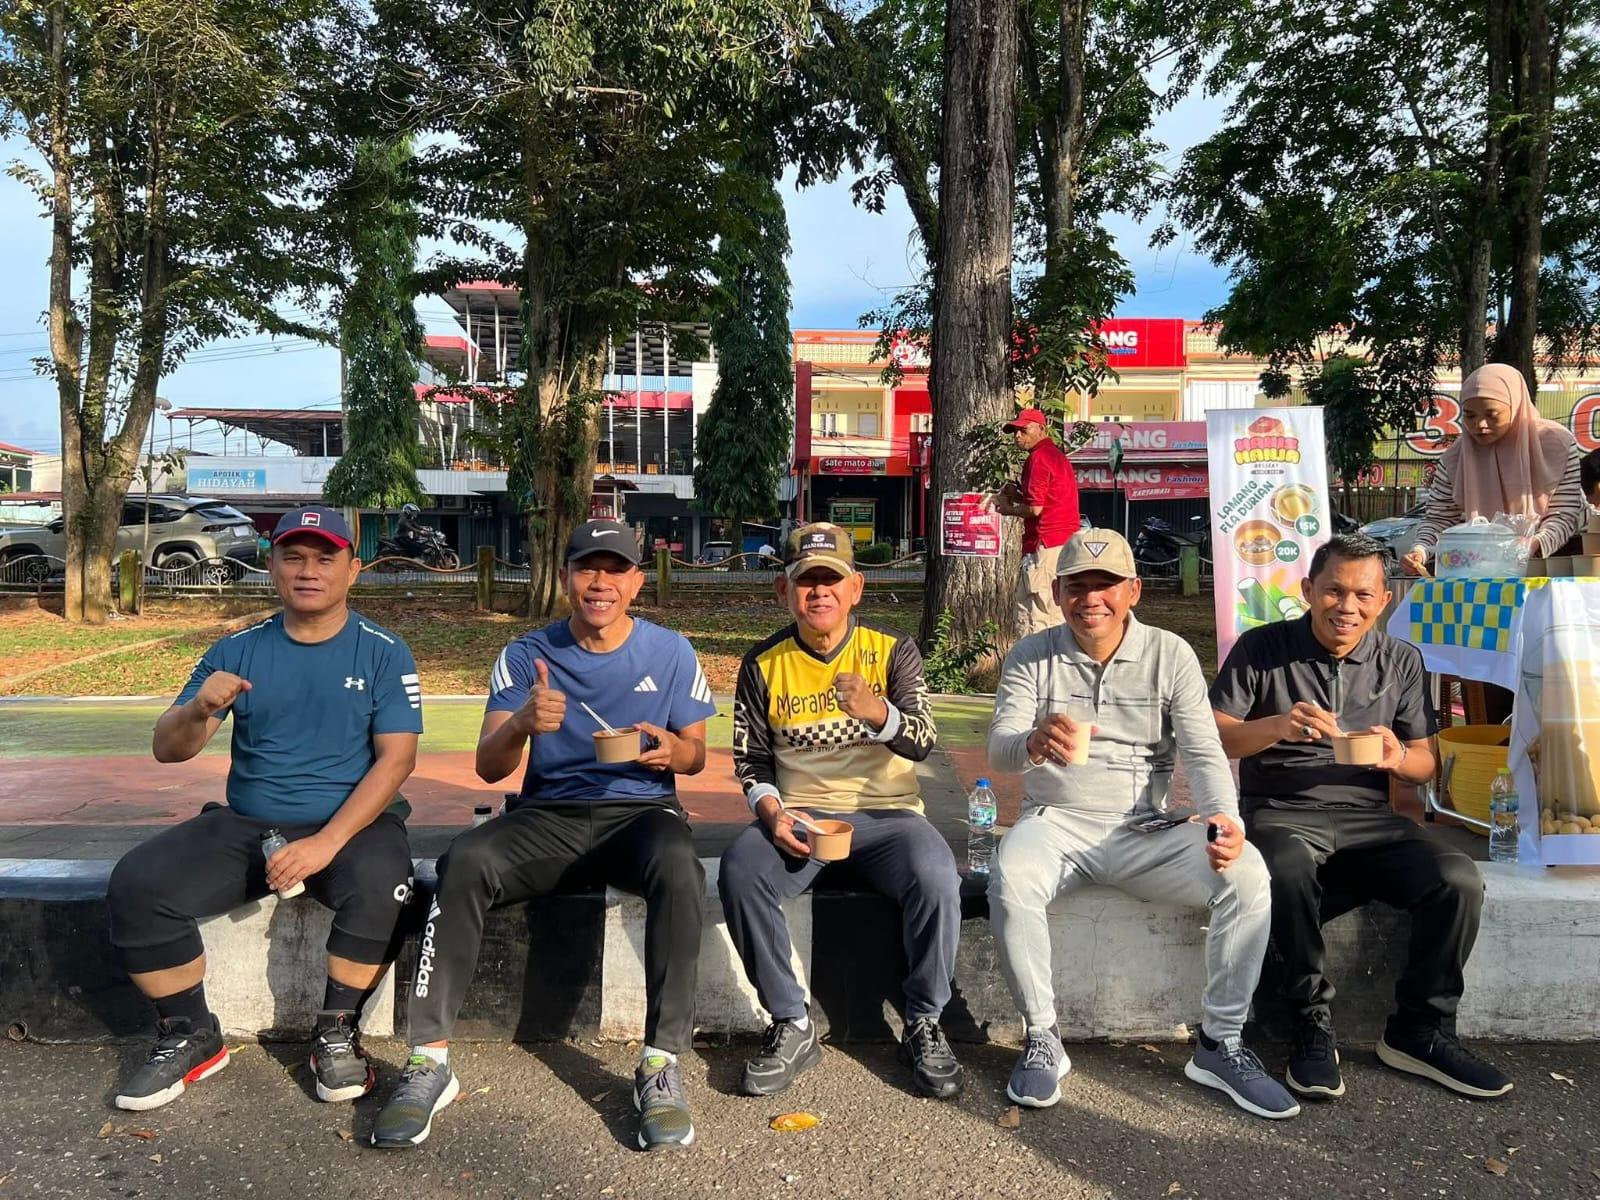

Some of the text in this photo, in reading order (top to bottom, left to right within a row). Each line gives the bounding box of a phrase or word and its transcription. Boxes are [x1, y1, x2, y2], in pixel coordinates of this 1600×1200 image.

[844, 459, 866, 467] mato
[1073, 467, 1161, 484] MILANG
[198, 478, 256, 488] HIDAYAH
[1217, 480, 1258, 519] LAMANG
[1219, 515, 1241, 534] FLA
[1237, 480, 1275, 516] DURIAN
[1298, 521, 1317, 531] 15K
[1277, 546, 1298, 556] 20K
[415, 922, 435, 997] adidas
